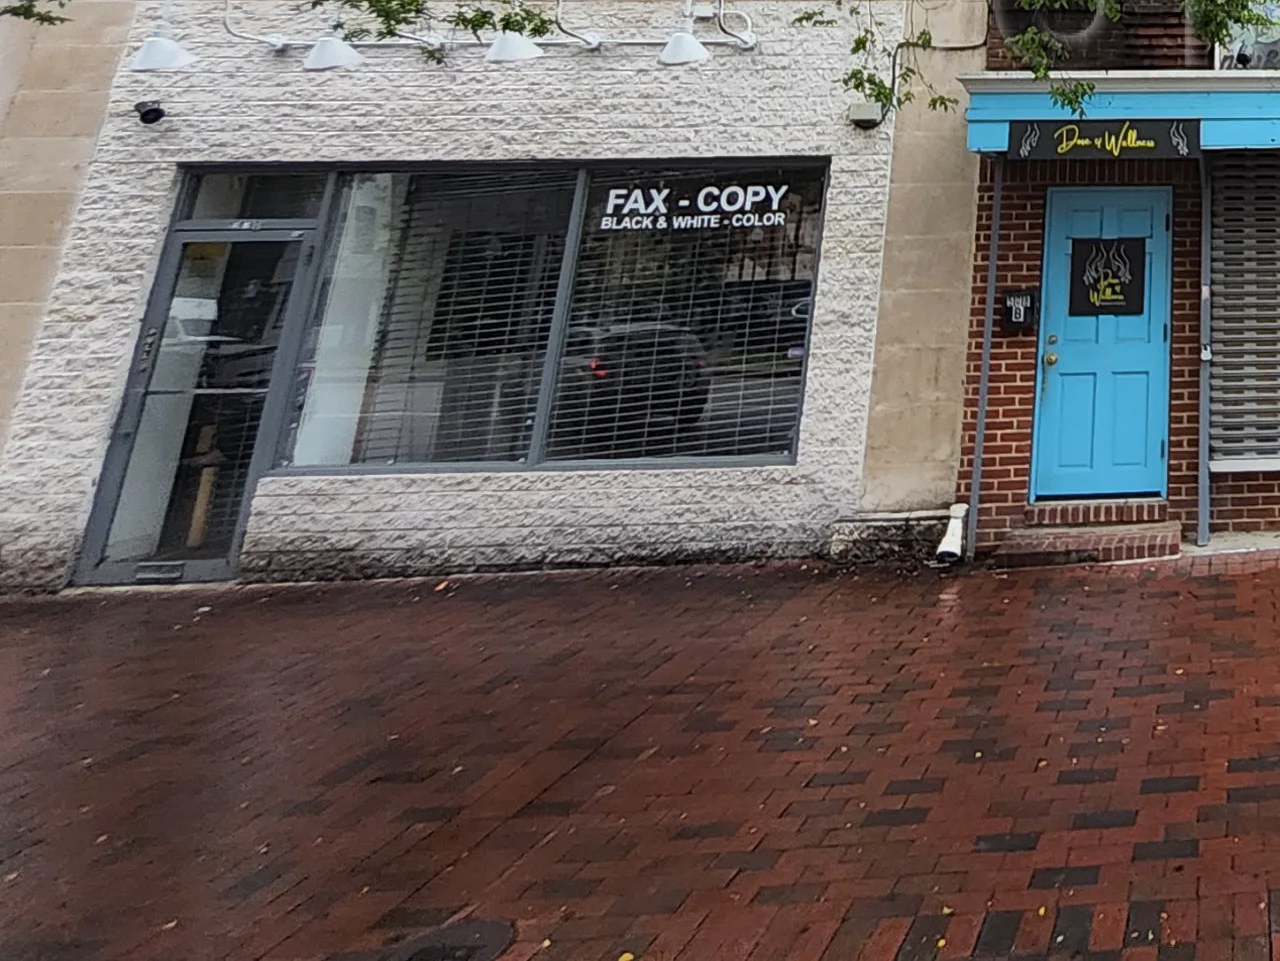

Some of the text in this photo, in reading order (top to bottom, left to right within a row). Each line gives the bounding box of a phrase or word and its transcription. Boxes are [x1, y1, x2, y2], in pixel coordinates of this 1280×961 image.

[605, 188, 671, 215] FAX
[696, 184, 790, 213] COPY
[600, 216, 654, 231] BLACK
[656, 215, 668, 229] &
[672, 214, 721, 229] WHITE
[731, 212, 786, 228] COLOR
